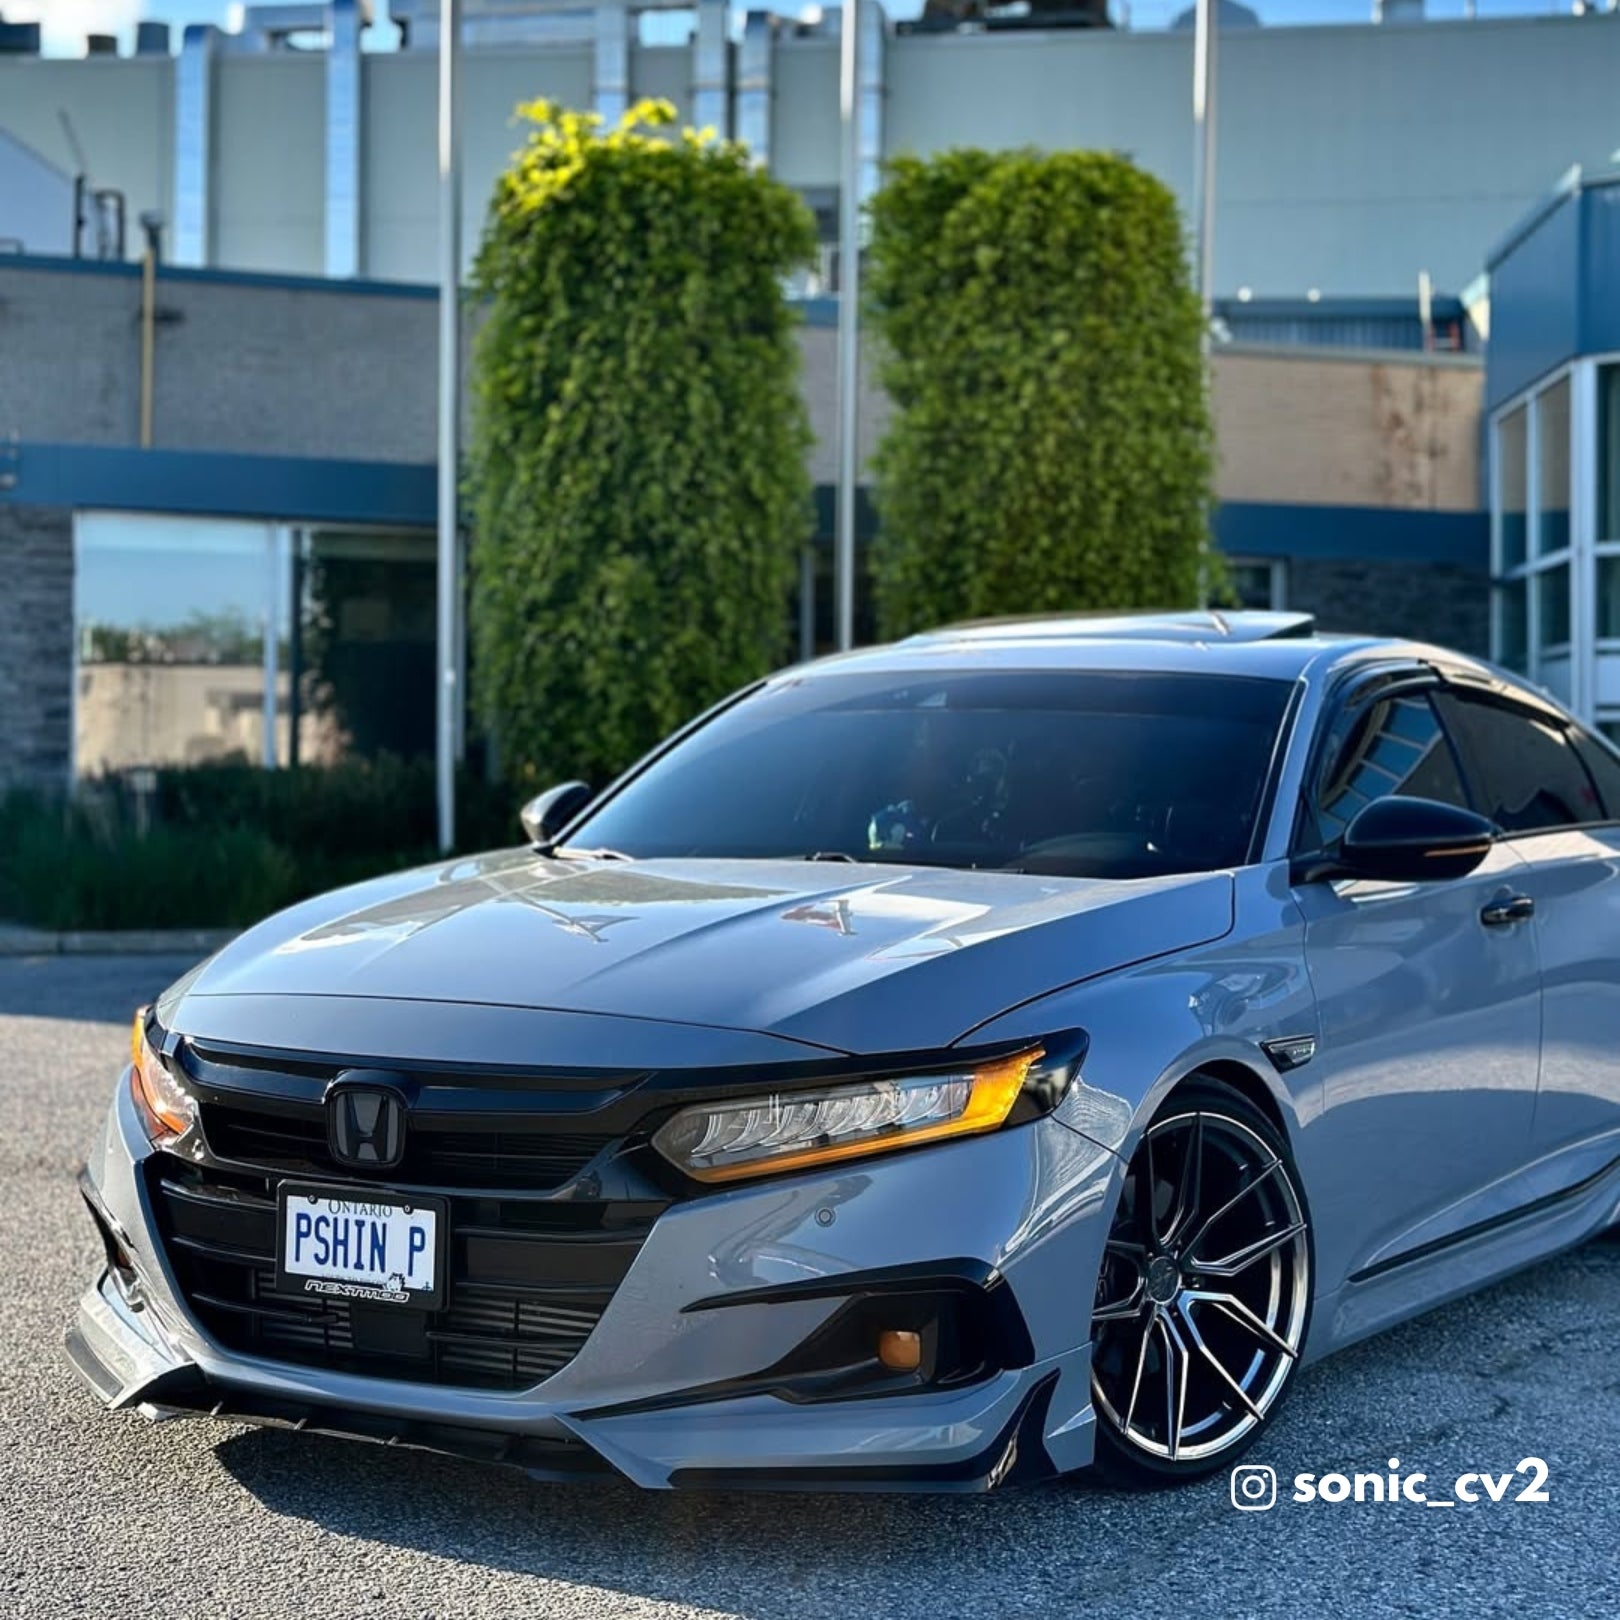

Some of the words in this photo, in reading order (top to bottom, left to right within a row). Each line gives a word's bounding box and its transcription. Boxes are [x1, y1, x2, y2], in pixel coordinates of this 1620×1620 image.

[328, 1200, 393, 1219] ONTARIO
[294, 1212, 387, 1274] PSHIN
[407, 1226, 426, 1278] P
